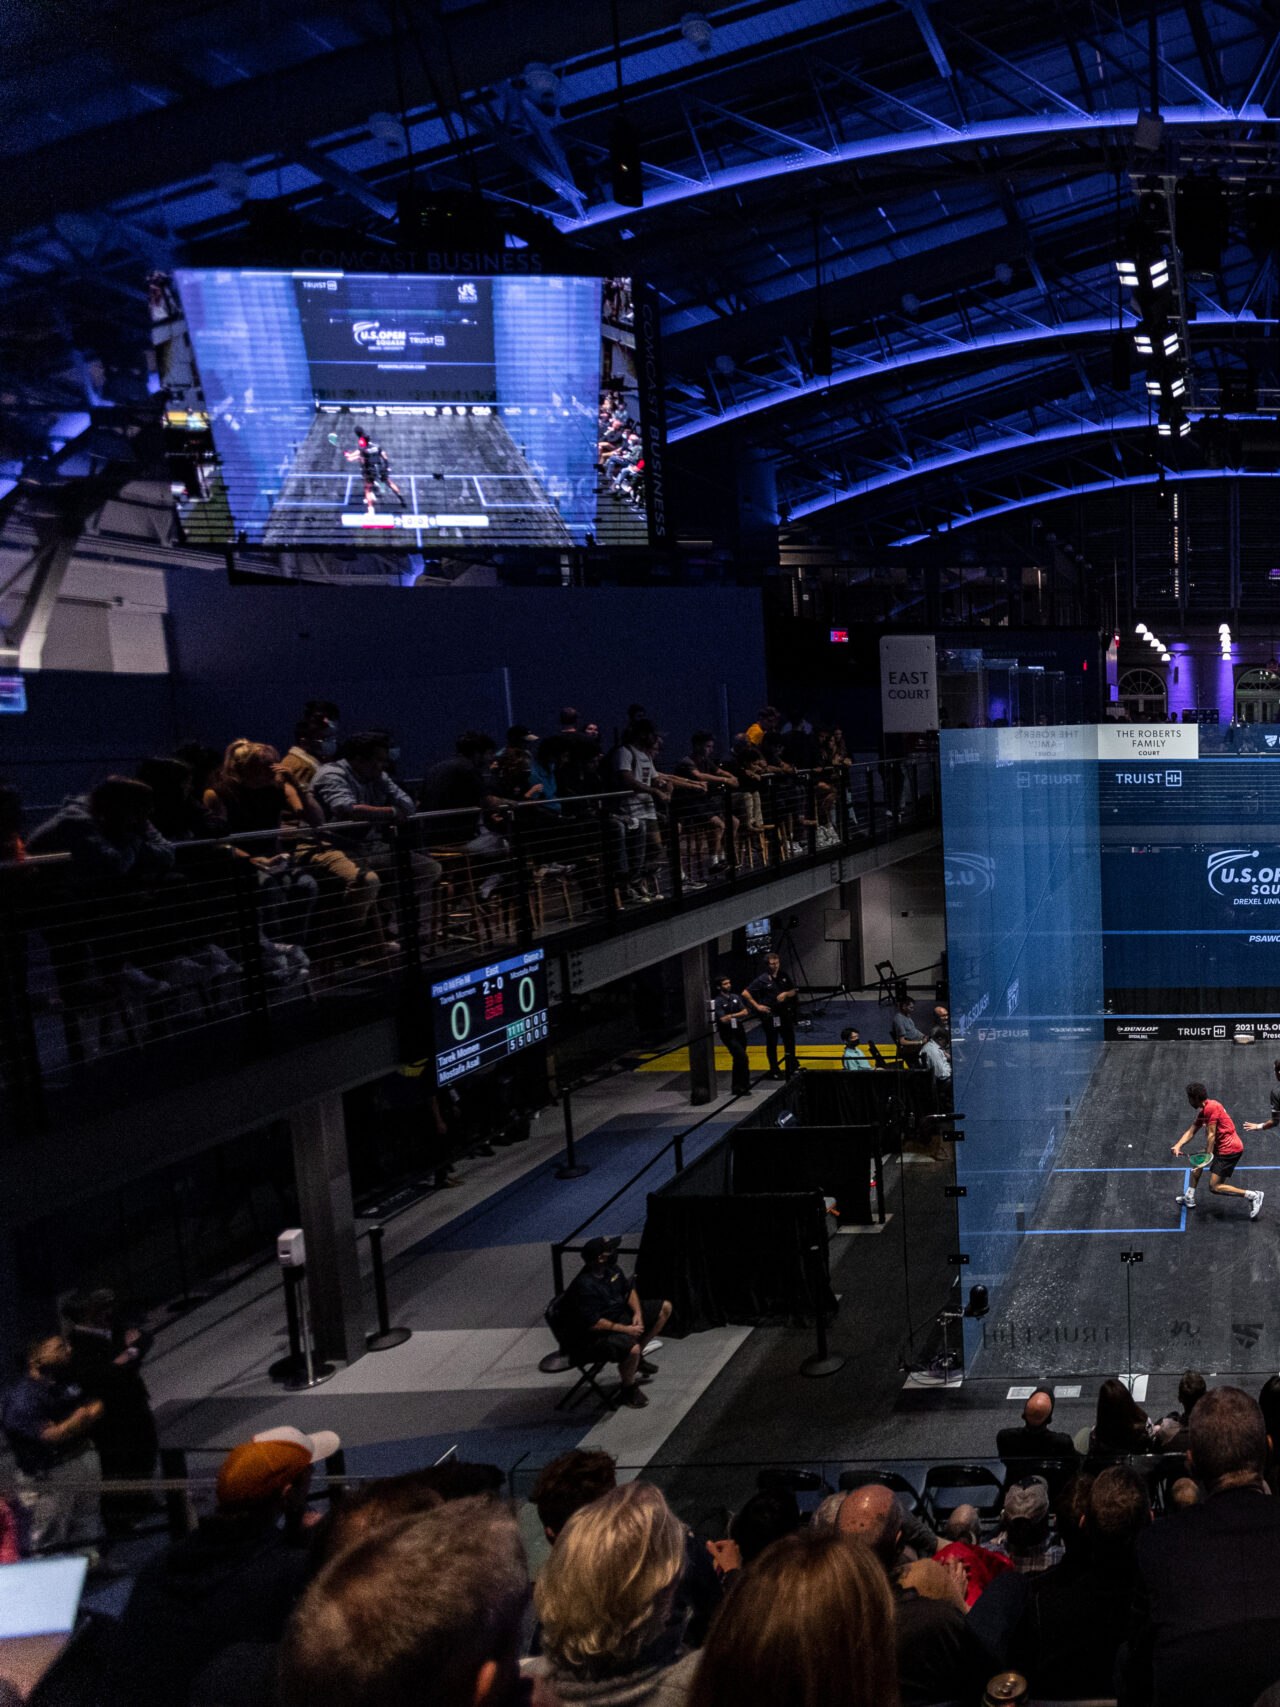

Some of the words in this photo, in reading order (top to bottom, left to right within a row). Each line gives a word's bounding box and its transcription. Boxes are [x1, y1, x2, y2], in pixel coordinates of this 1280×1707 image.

[301, 249, 417, 271] COMCAST
[428, 252, 543, 273] BUSINESS
[642, 304, 658, 416] COMCAST
[649, 425, 666, 537] BUSINESS
[888, 672, 929, 685] EAST
[888, 689, 929, 700] COURT
[1116, 730, 1136, 738] THE
[1138, 730, 1182, 738] ROBERTS
[1132, 739, 1166, 748] FAMILY
[1116, 774, 1162, 784] TRUIST
[485, 965, 499, 977] East
[518, 976, 535, 1013] 0
[451, 1001, 471, 1041] 0
[525, 1018, 531, 1029] 0
[533, 1015, 539, 1025] 0
[541, 1011, 547, 1022] 0
[510, 1039, 516, 1050] 5
[518, 1036, 524, 1047] 5
[526, 1032, 532, 1043] 0
[534, 1028, 540, 1039] 0
[542, 1025, 548, 1036] 0
[1178, 1027, 1212, 1036] TRUIST
